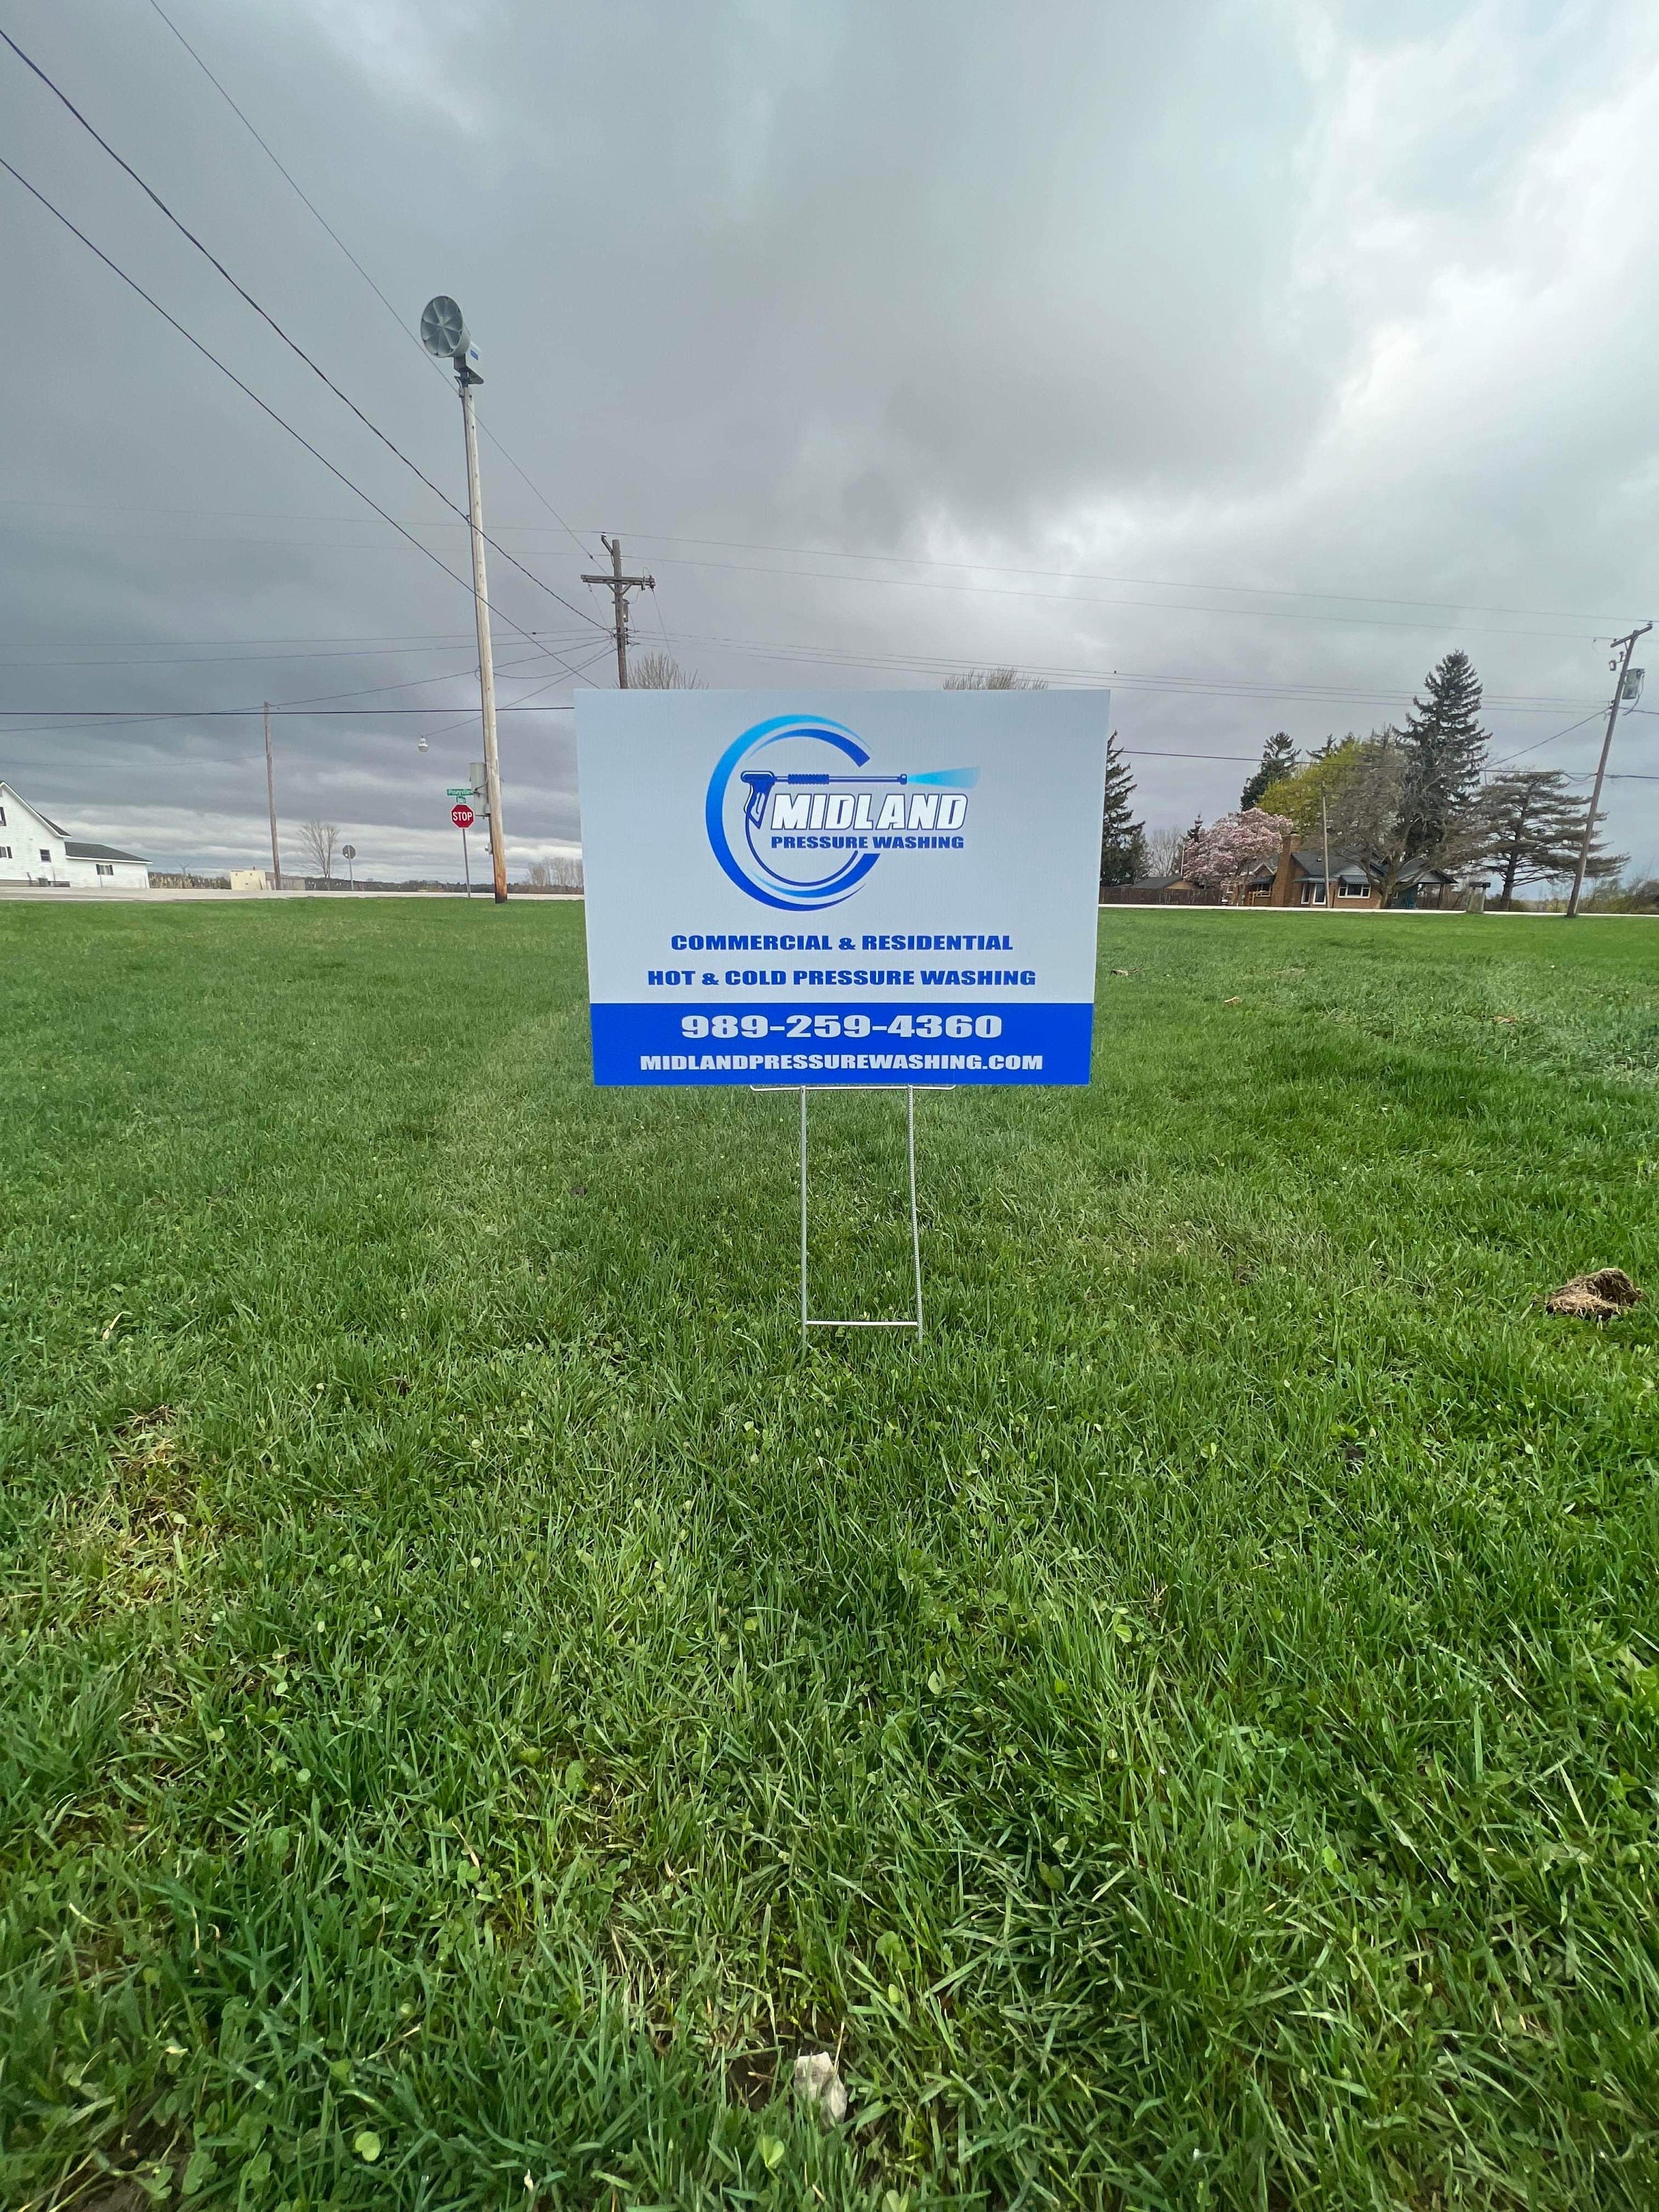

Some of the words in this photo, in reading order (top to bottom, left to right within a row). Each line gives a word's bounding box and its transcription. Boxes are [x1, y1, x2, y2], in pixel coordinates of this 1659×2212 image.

[453, 811, 472, 821] STOP
[771, 793, 967, 830] MIDLAND
[771, 837, 868, 849] PRESSURE
[873, 837, 964, 849] WASHING
[671, 935, 832, 950] COMMERCIAL
[838, 937, 855, 950] &
[862, 935, 1013, 950] RESIDENTIAL
[648, 970, 696, 985] HOT
[702, 973, 719, 985] &
[725, 970, 786, 985] COLD
[793, 970, 914, 985] PRESSURE
[920, 970, 1036, 985] WASHING
[681, 1015, 1002, 1038] 989-259-4360
[640, 1054, 1043, 1070] MIDLANDPRESSUREWASHING.COM
